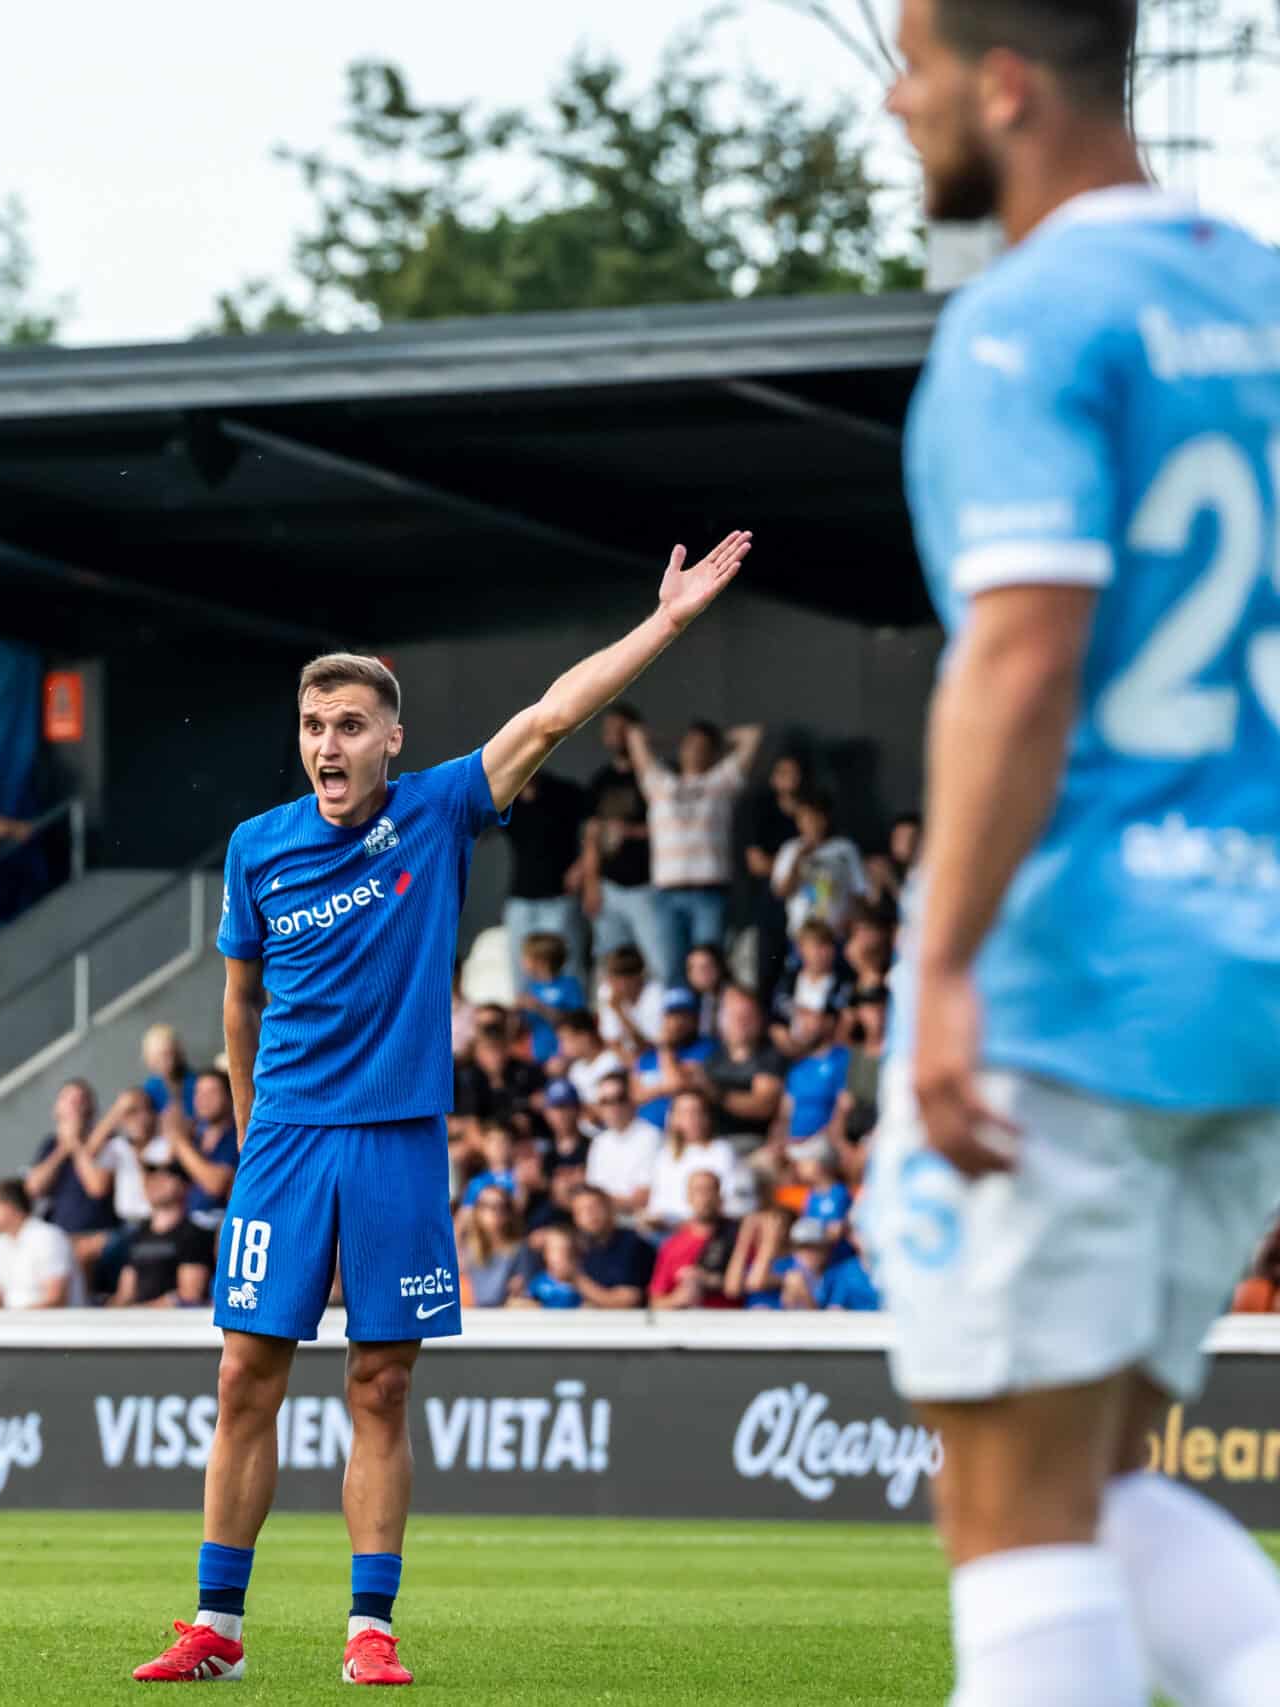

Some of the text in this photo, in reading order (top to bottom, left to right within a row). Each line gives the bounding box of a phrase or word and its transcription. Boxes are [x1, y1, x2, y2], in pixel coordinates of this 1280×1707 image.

[1096, 433, 1280, 756] 2
[228, 1217, 271, 1282] 18
[400, 1267, 453, 1297] melt
[425, 1380, 611, 1471] VIETĀ!
